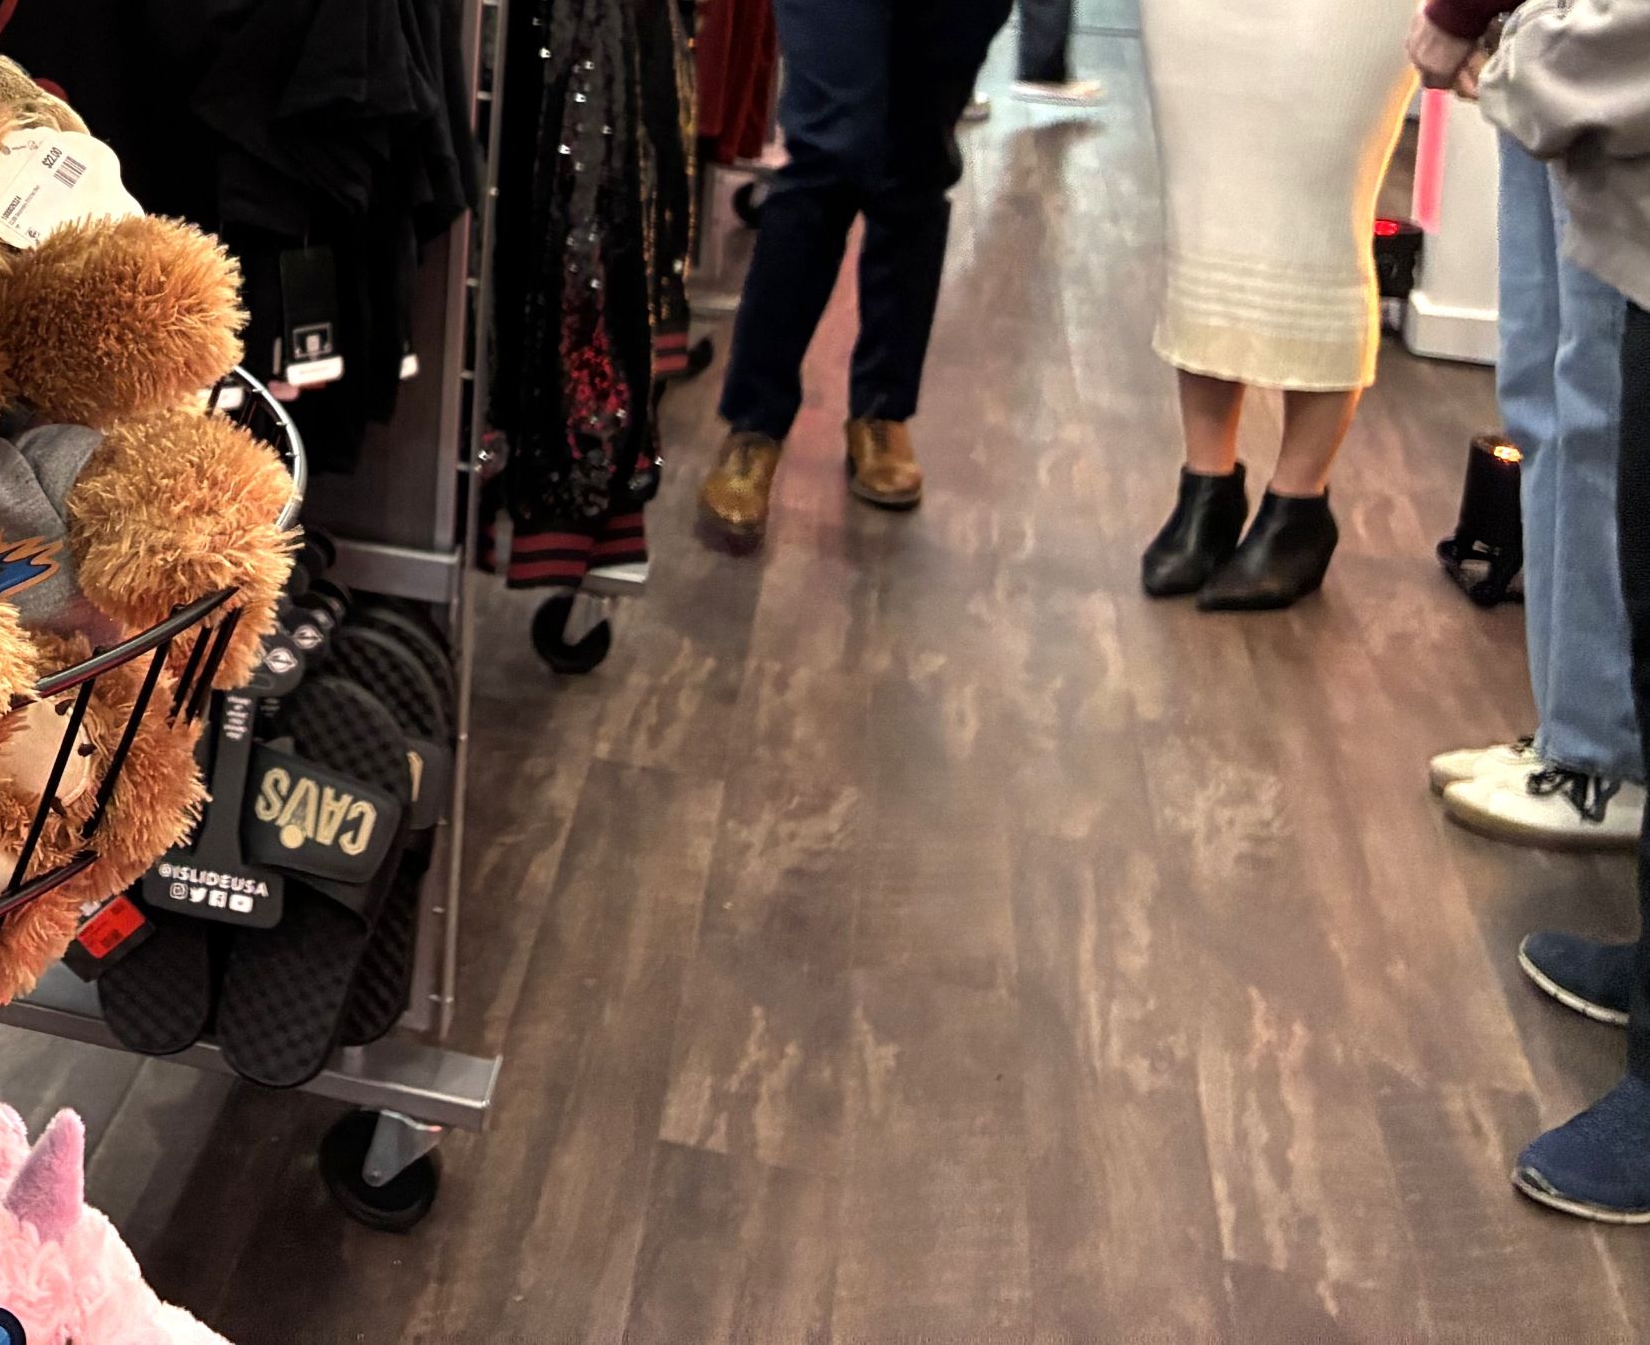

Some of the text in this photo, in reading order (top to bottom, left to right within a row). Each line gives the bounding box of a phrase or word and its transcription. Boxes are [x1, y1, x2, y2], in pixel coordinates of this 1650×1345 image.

[41, 146, 63, 169] $22.00
[255, 767, 377, 855] CAVS
[159, 863, 269, 897] @ISLIDEUSA
